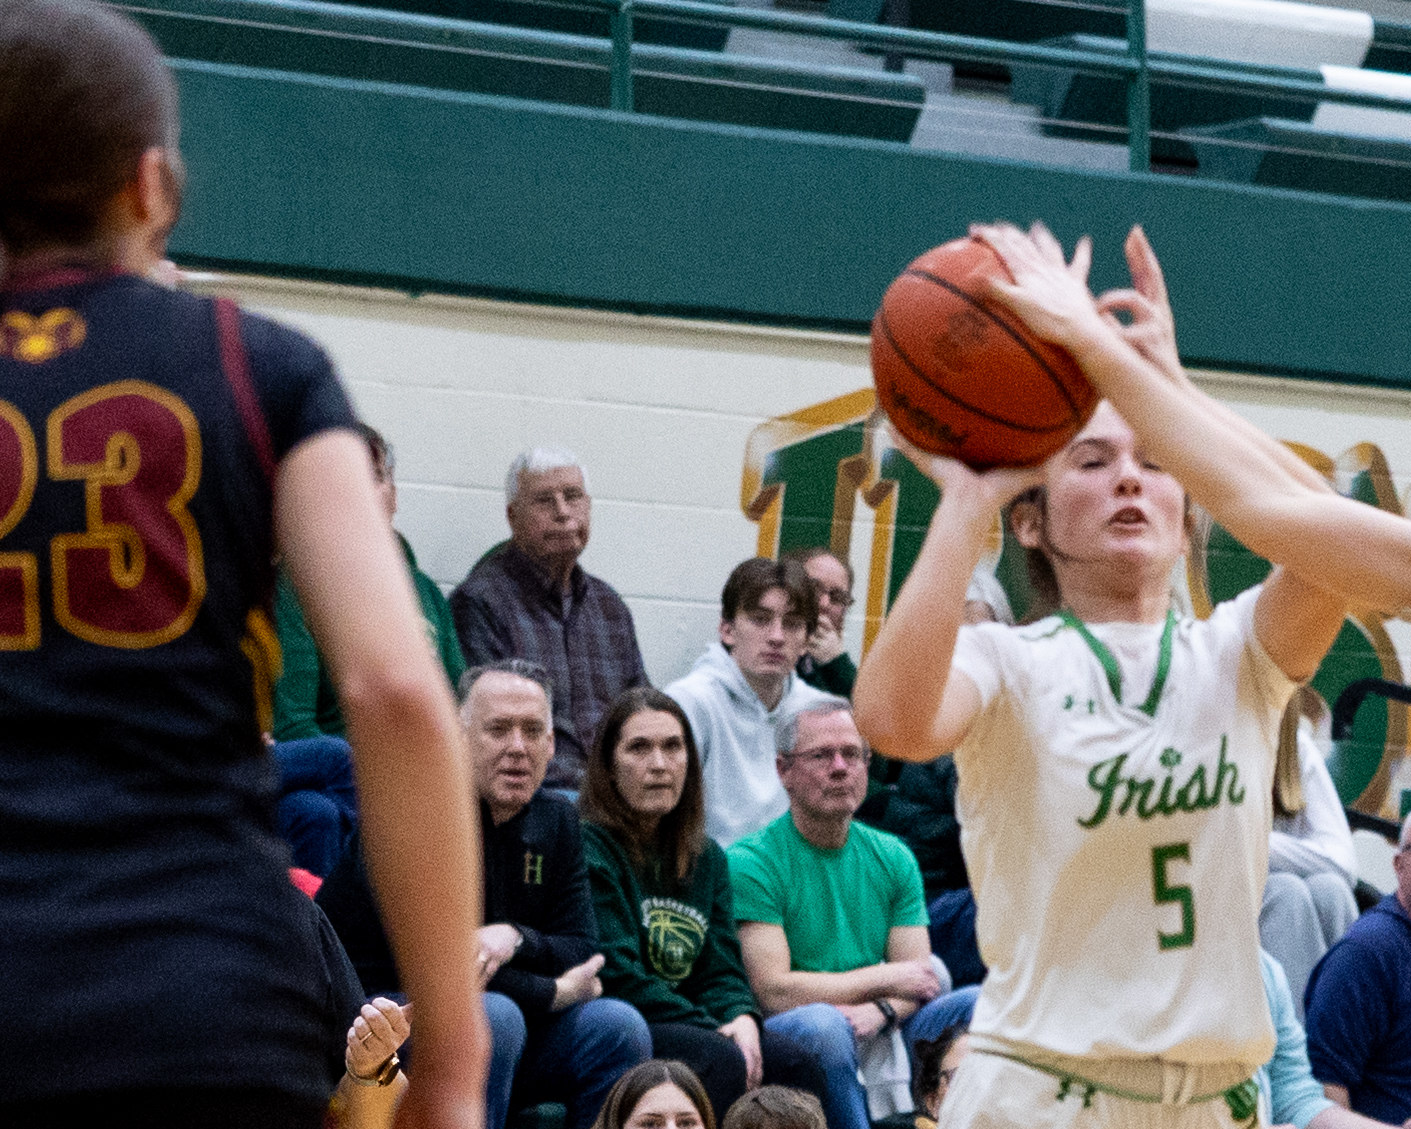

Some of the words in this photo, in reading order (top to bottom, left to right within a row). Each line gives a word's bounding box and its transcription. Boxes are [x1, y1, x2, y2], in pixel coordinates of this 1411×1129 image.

[0, 379, 206, 650] 3
[1077, 733, 1246, 830] Irish
[1151, 842, 1196, 953] 5
